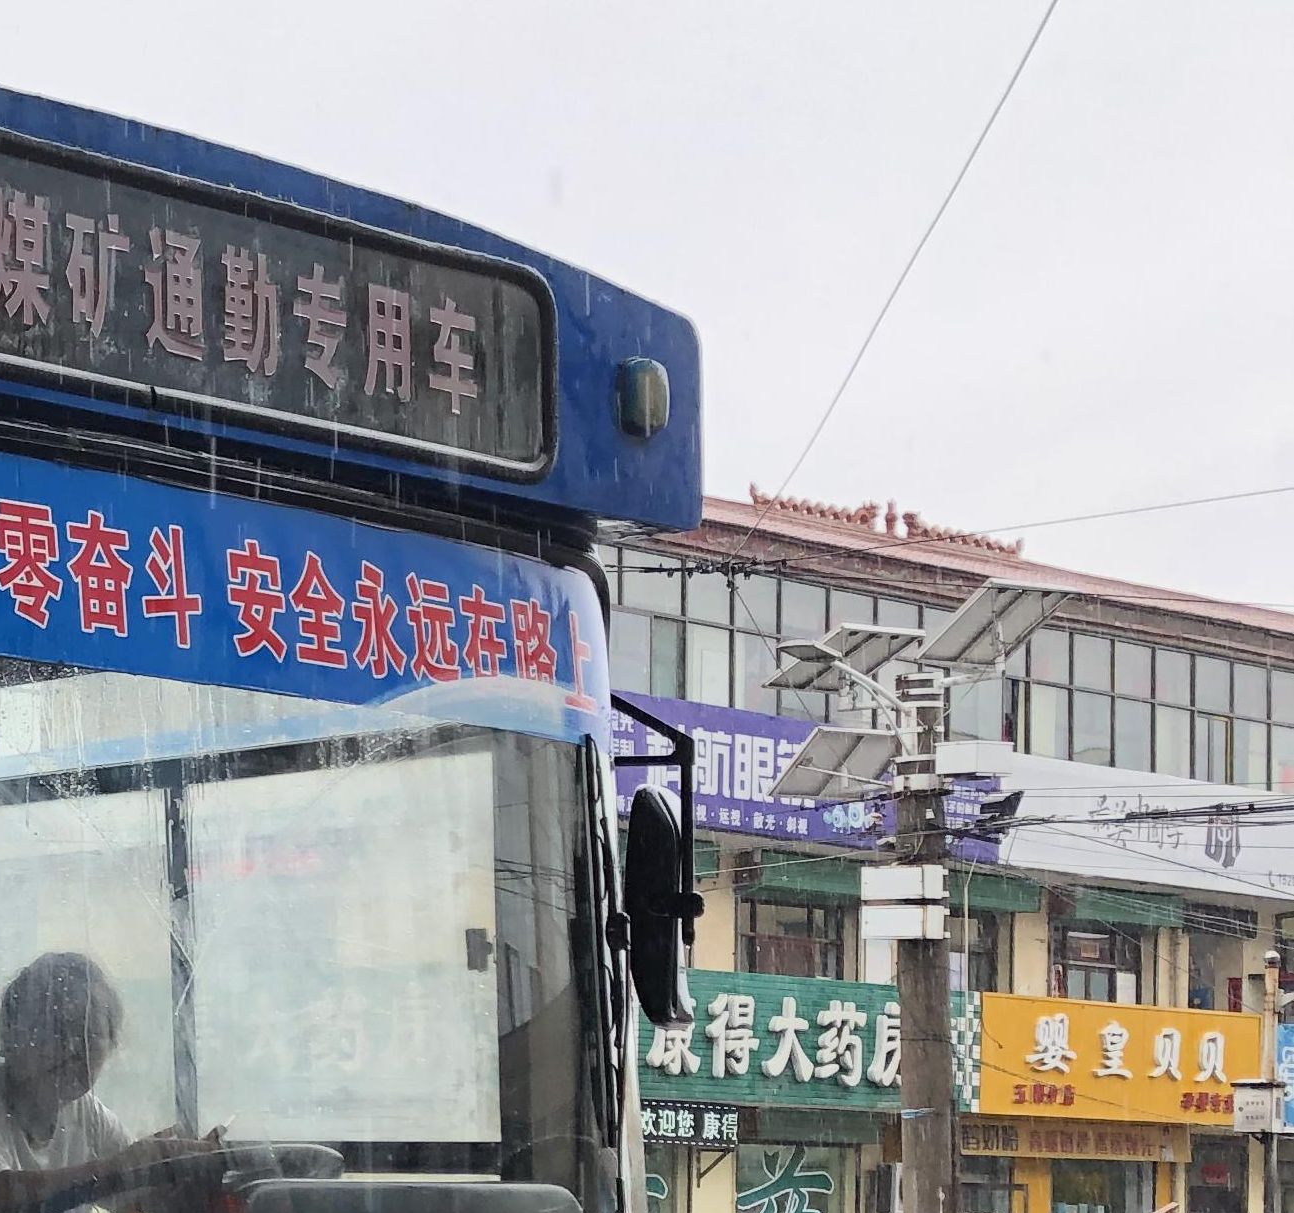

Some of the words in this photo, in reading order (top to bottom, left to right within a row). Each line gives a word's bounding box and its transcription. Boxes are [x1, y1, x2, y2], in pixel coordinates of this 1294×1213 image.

[225, 539, 597, 715] 安全永远在路上
[1025, 1013, 1227, 1083] 婴皇贝贝
[641, 1107, 695, 1138] 欢迎您
[702, 1111, 739, 1141] 康得
